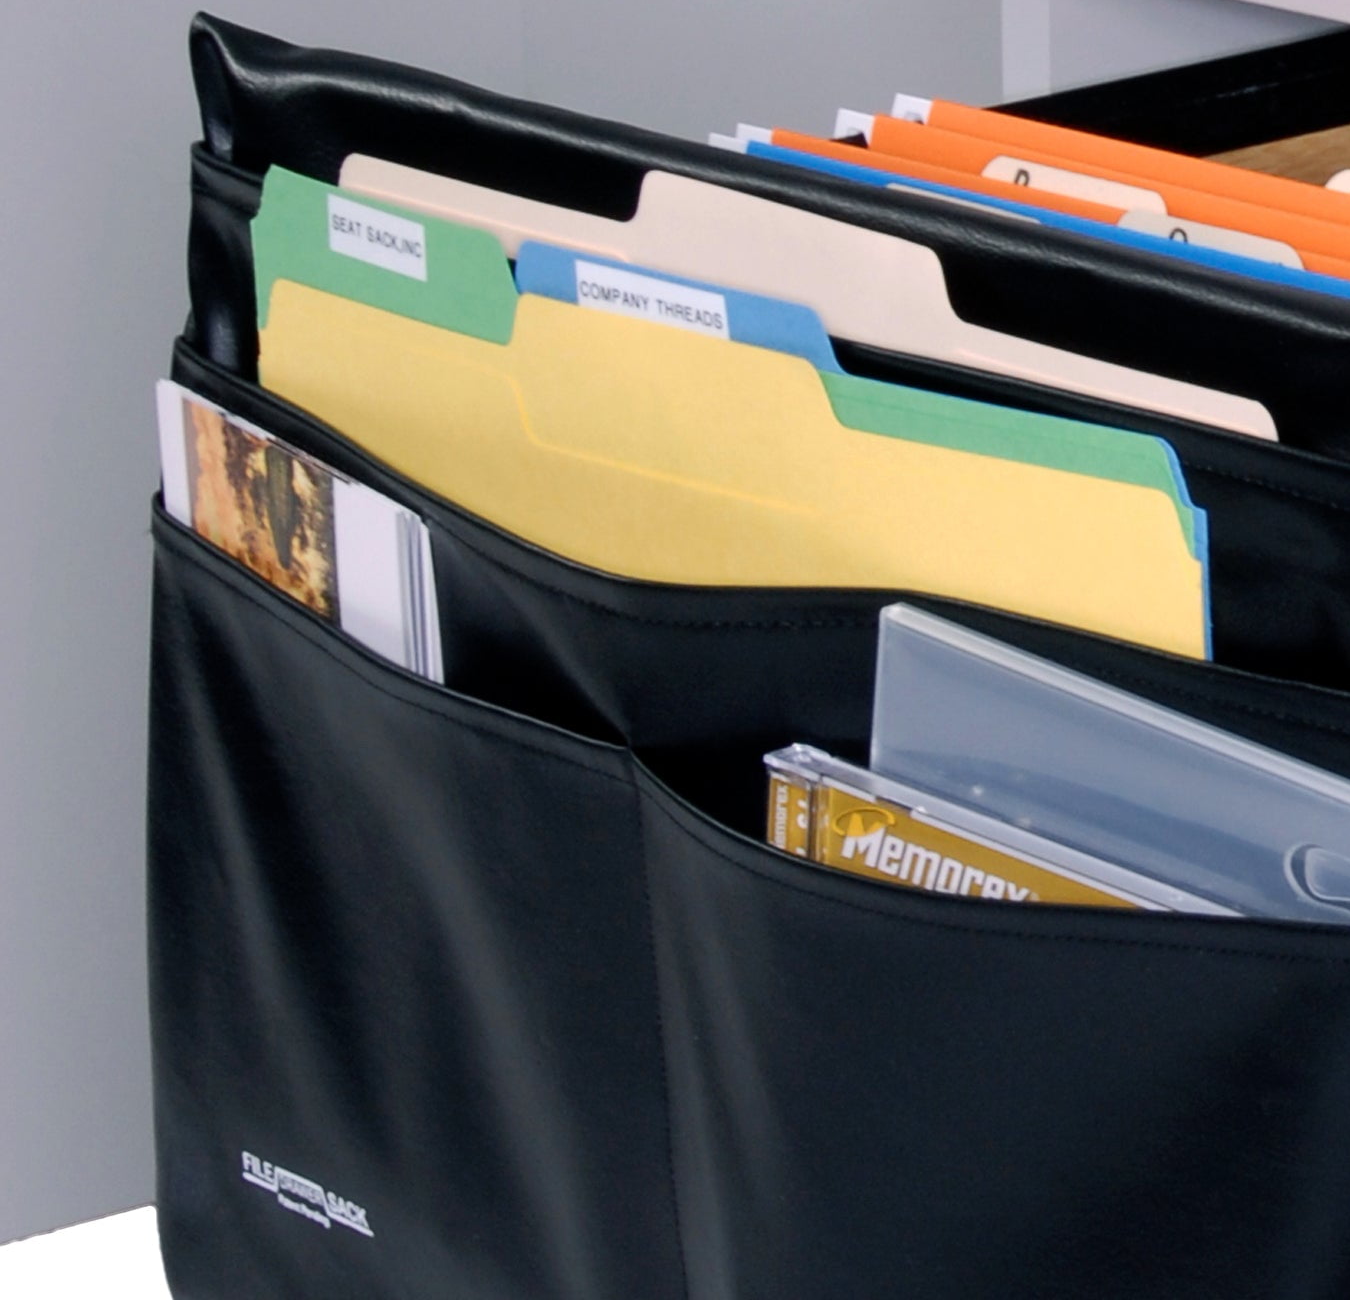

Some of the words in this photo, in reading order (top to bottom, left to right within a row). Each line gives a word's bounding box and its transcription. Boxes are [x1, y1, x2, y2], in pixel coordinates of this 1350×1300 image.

[333, 214, 361, 237] SEAT
[579, 280, 650, 311] COMPANY
[656, 299, 724, 330] THREADS
[841, 812, 1030, 902] Memorex
[242, 1150, 275, 1183] FILE
[327, 1191, 370, 1230] SACK
